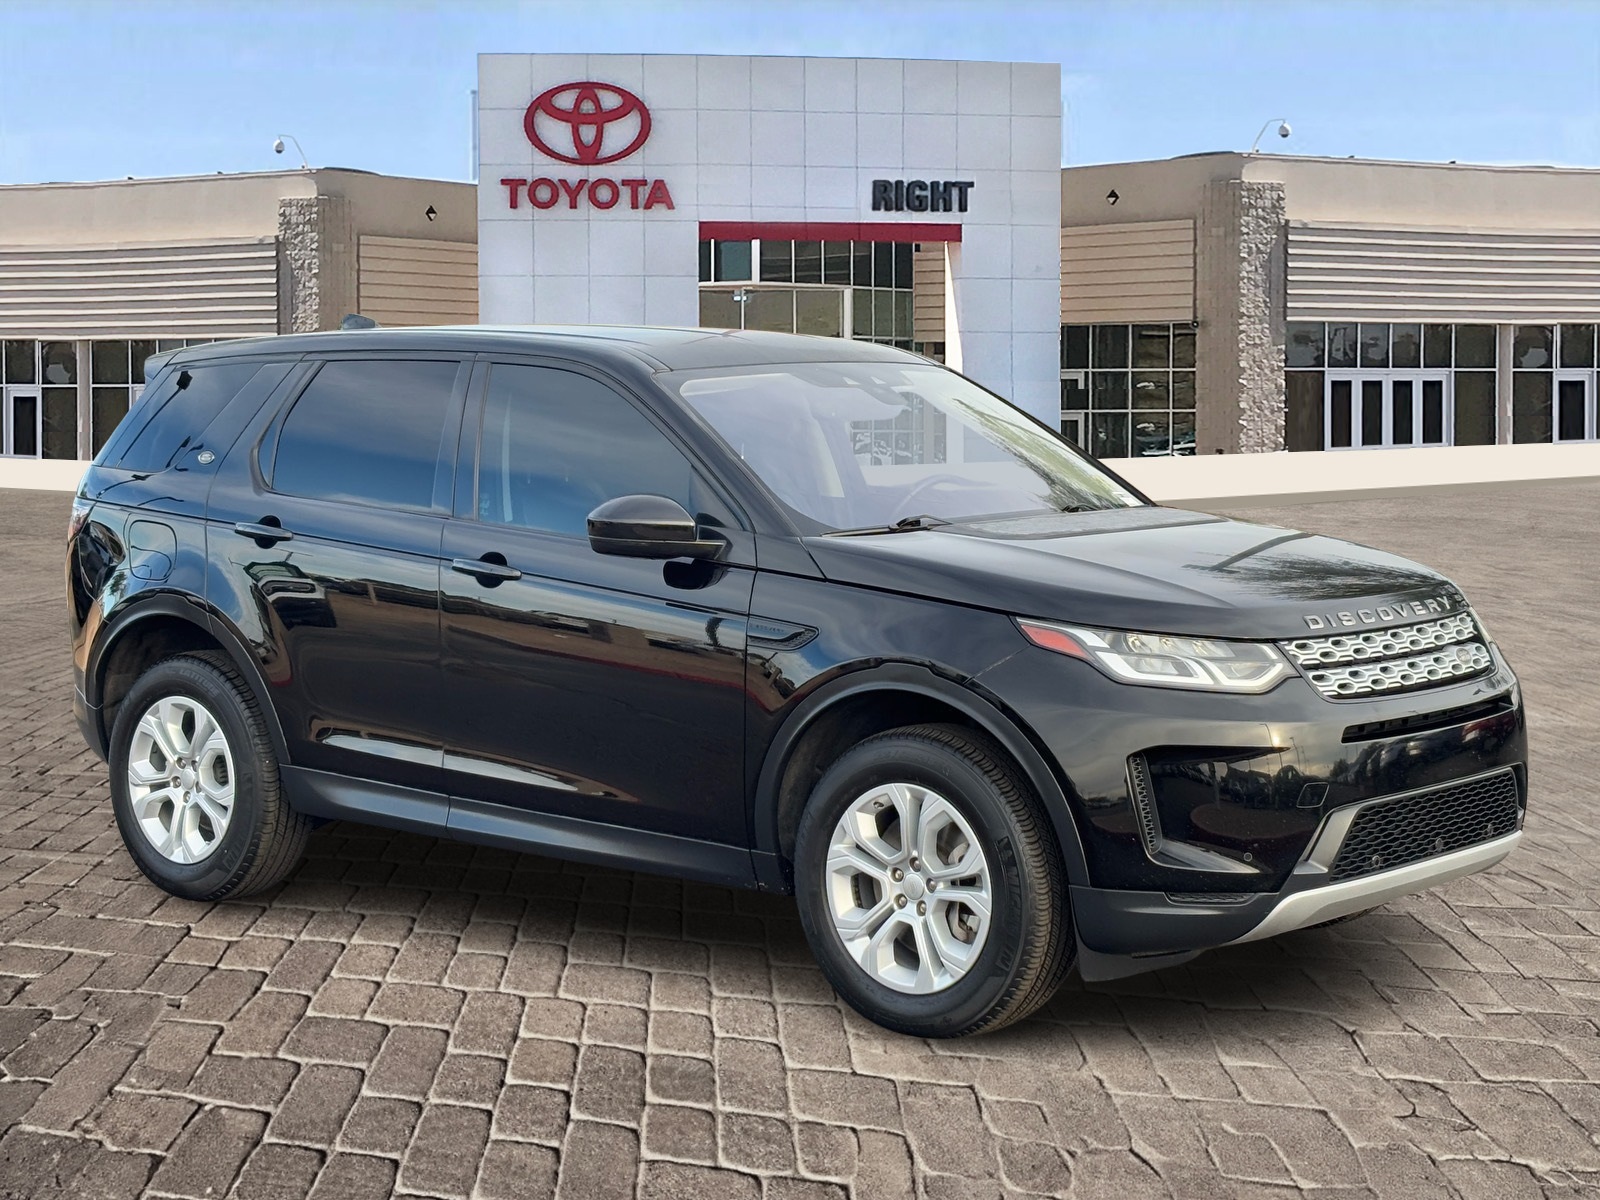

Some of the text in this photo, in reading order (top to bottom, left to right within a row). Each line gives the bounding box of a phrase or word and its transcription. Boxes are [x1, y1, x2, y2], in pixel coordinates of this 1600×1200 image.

[501, 179, 675, 210] TOYOTA
[872, 180, 975, 213] RIGHT
[1303, 597, 1451, 630] DISCOVERY
